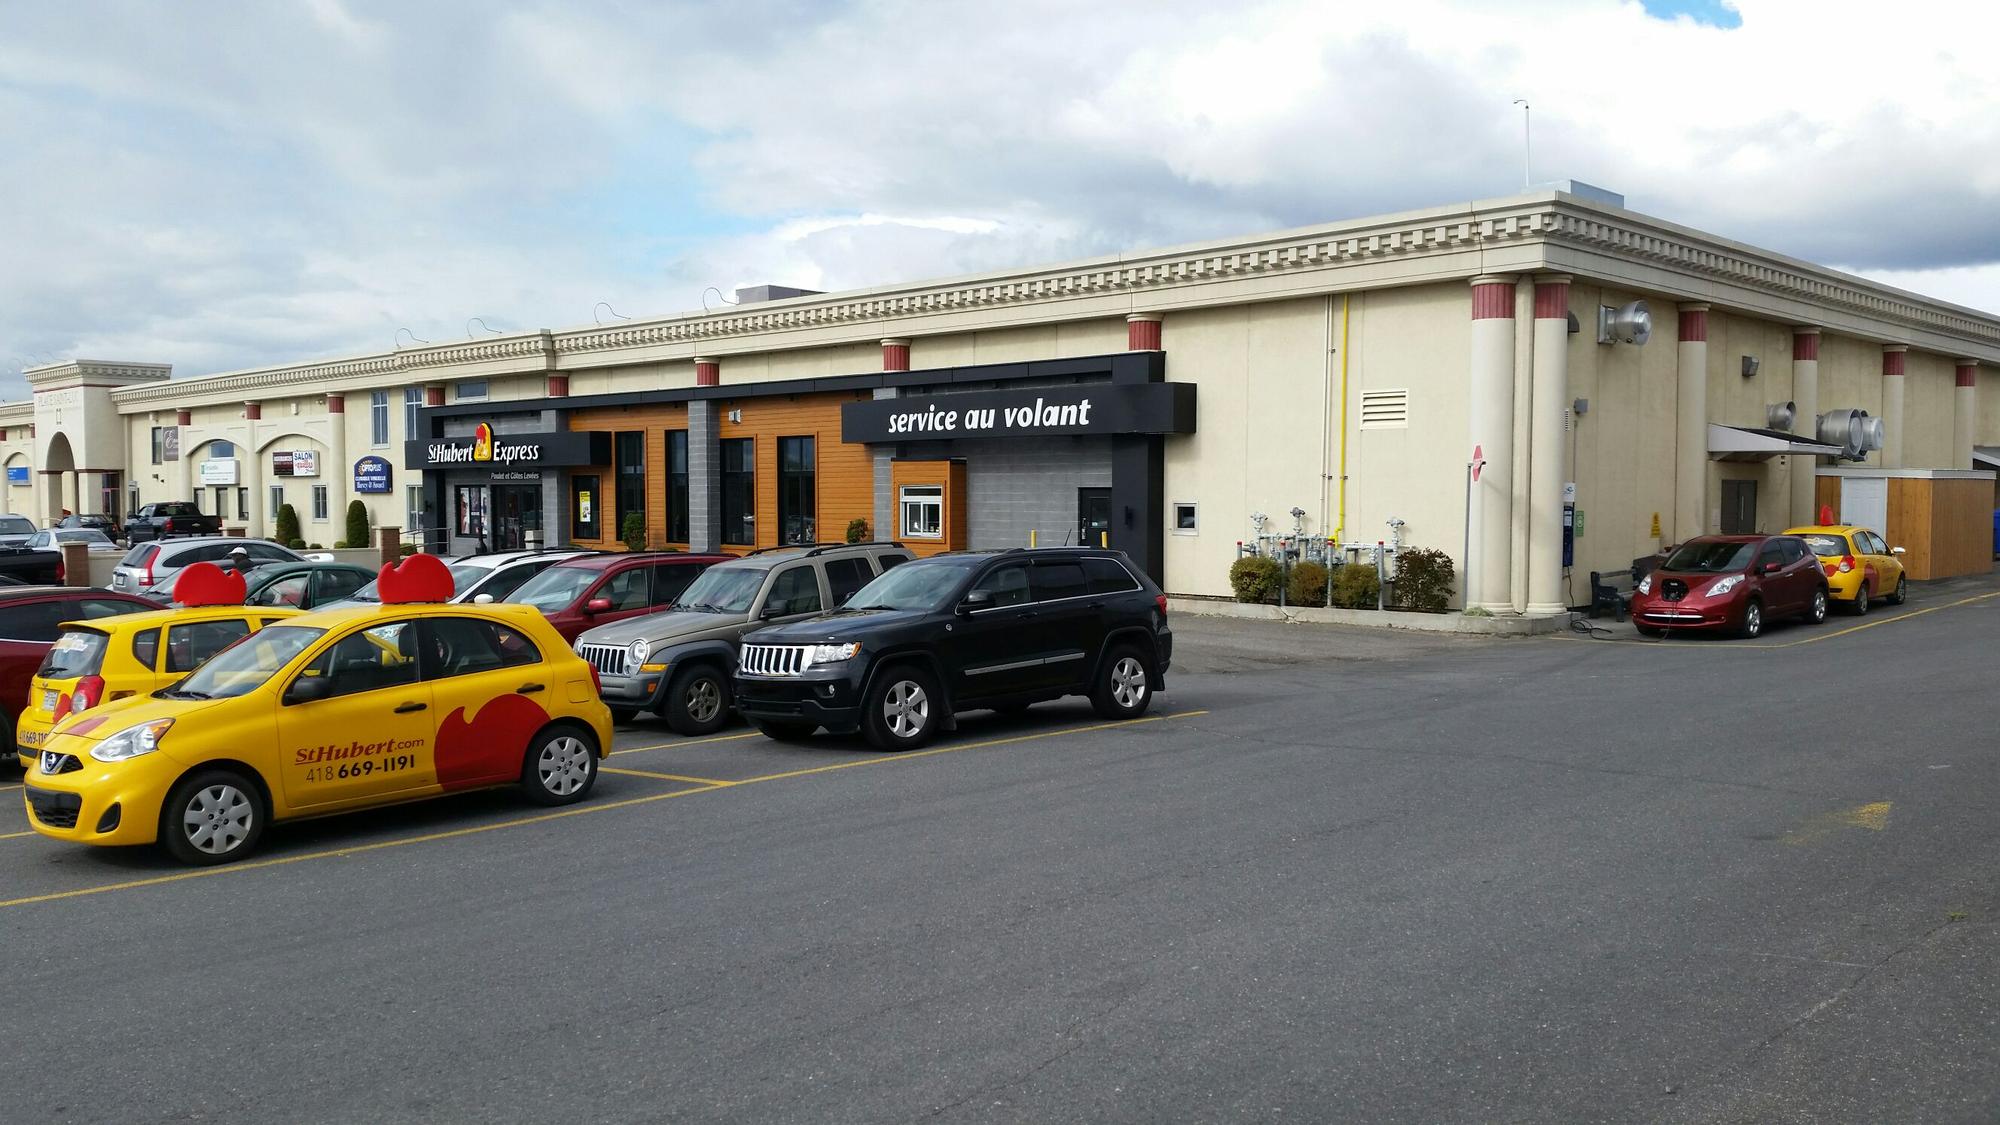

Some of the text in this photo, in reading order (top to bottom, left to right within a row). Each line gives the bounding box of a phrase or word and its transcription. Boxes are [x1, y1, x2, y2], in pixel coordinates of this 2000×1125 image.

[888, 398, 1092, 433] service au volant
[294, 452, 313, 461] SALON
[493, 441, 540, 466] Express
[504, 472, 510, 480] et
[306, 754, 415, 784] 418 669-1191
